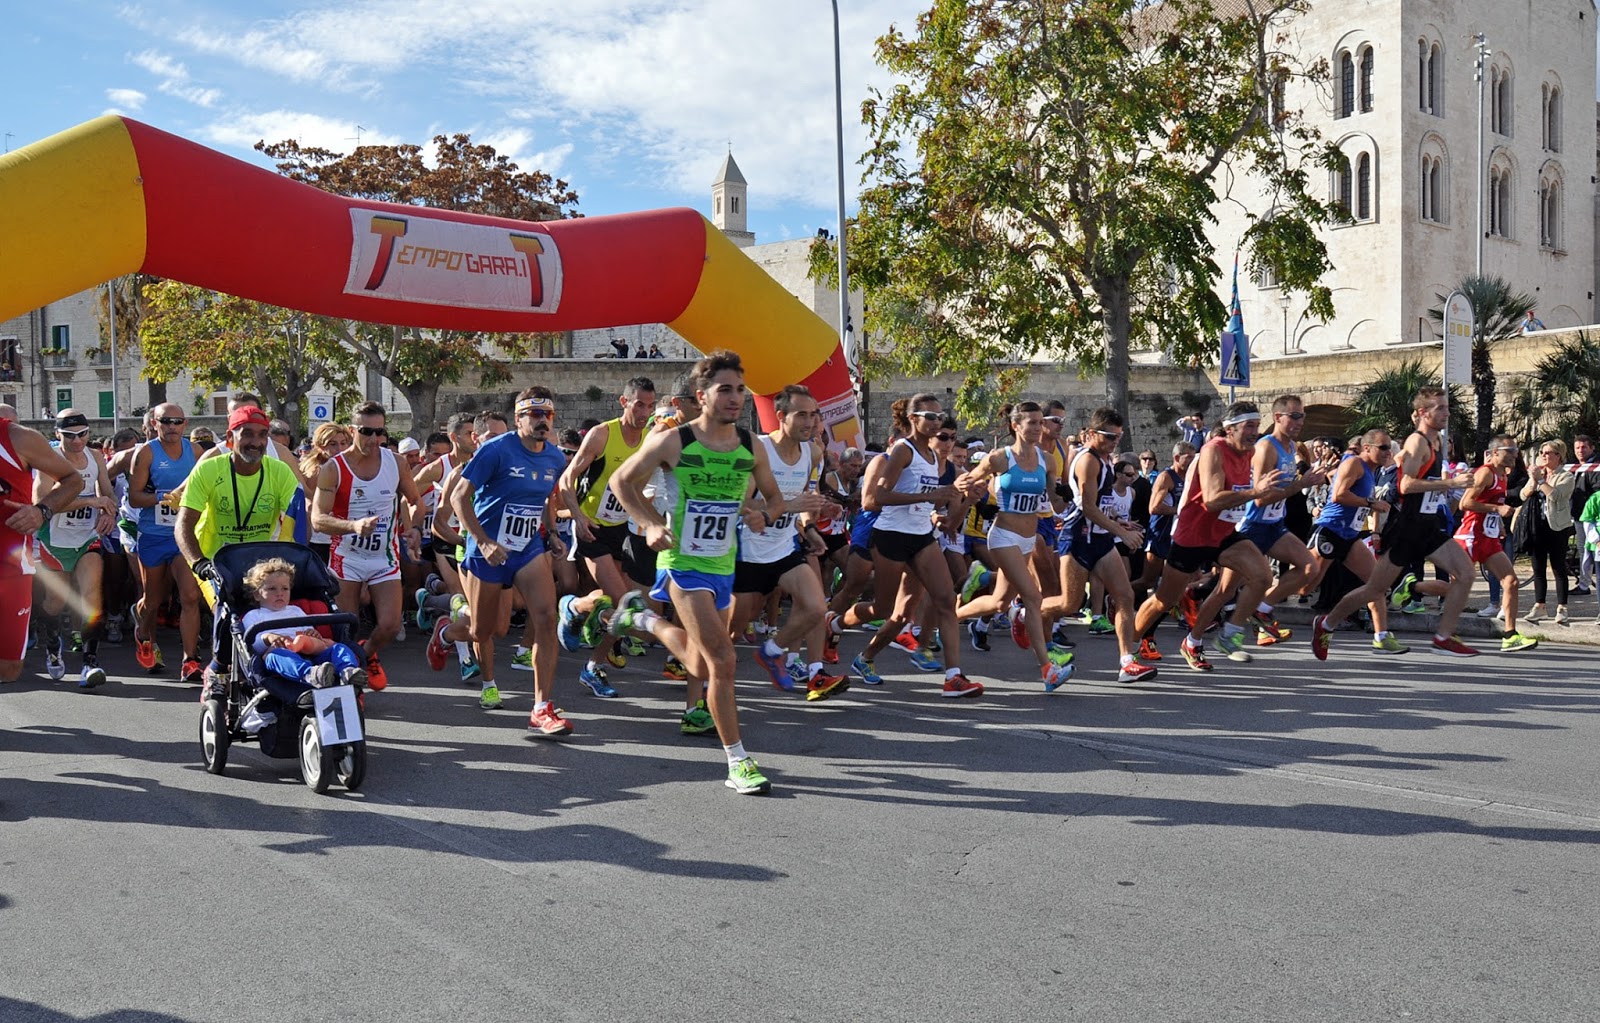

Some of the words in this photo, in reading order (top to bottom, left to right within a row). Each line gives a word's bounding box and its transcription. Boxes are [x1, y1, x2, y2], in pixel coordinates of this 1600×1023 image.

[505, 515, 537, 538] 1016
[693, 515, 729, 540] 129
[350, 534, 381, 551] 1115
[322, 697, 347, 740] 1
